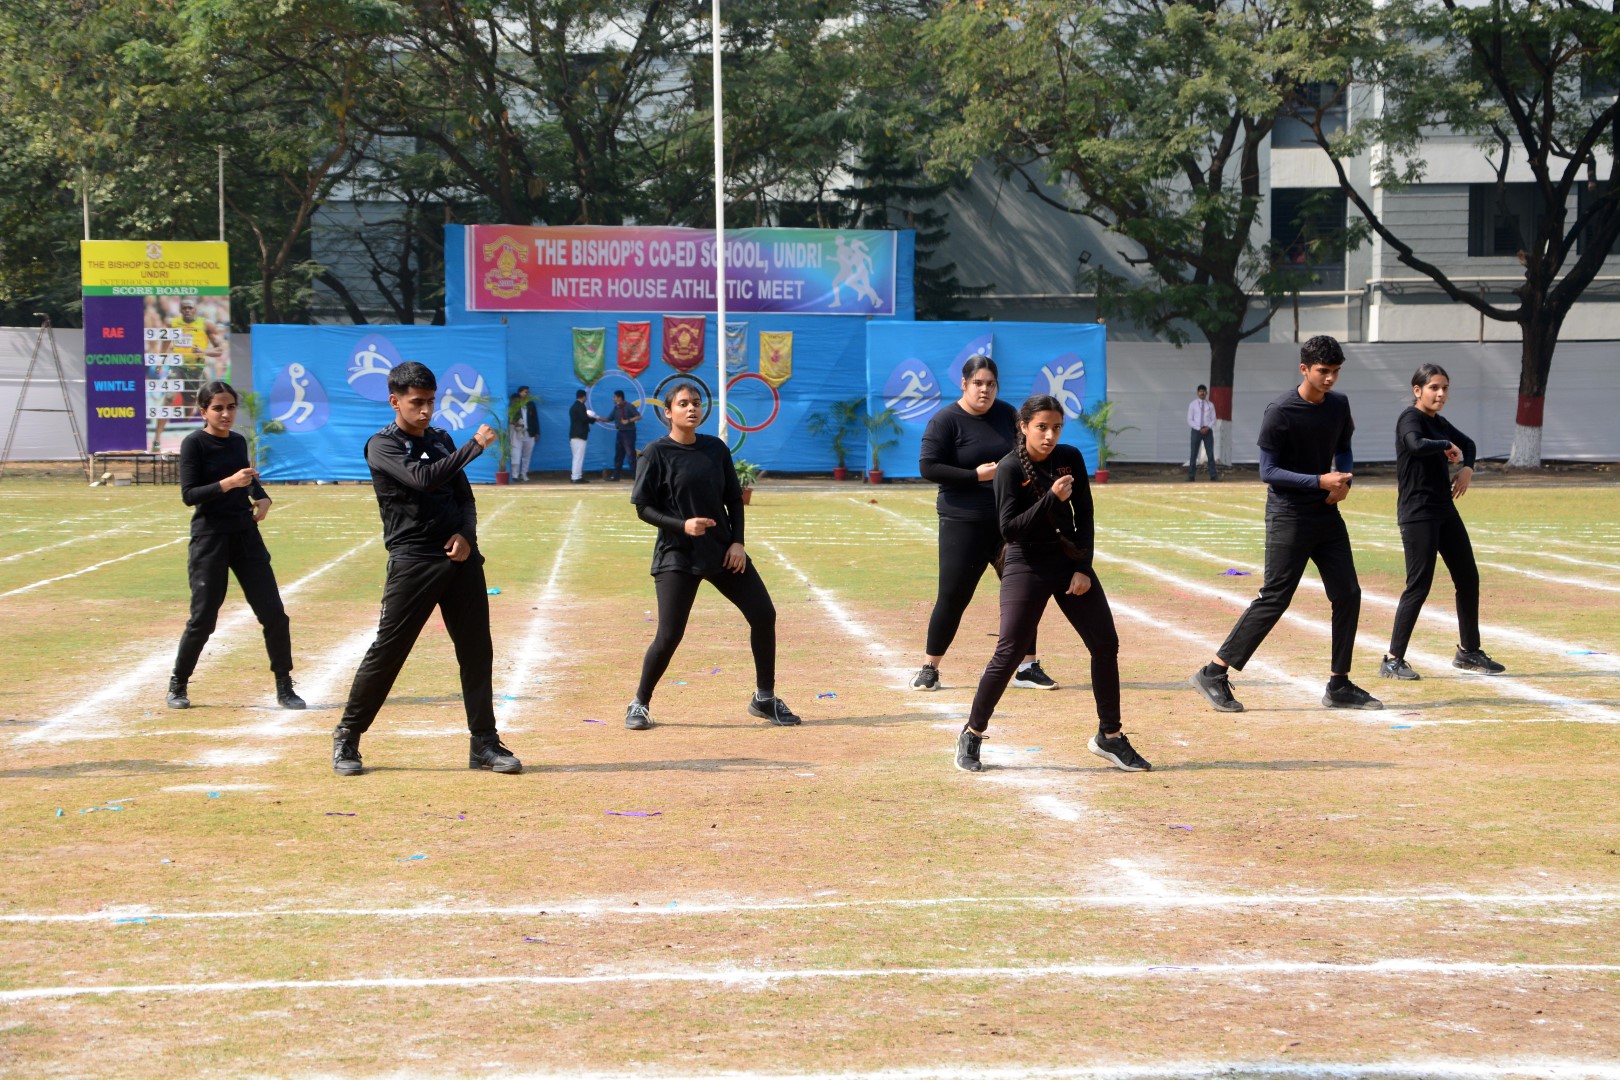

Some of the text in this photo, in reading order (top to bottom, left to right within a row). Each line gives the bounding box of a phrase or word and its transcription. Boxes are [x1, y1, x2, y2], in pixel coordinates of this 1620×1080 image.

[535, 239, 567, 265] THE
[571, 239, 645, 267] BISHOP'S
[648, 240, 696, 267] CO-ED
[773, 242, 822, 269] UNDRI
[88, 261, 220, 270] THE BISHOP'S CO-ED SCHOOL
[112, 286, 198, 295] SCORE BOARD
[551, 277, 805, 300] INTER HOUSE ATHLTIC MEET
[103, 328, 124, 338] RAE
[86, 354, 142, 364] O'CONNOR
[94, 381, 136, 391] WINTLE
[96, 407, 135, 418] YOUNG
